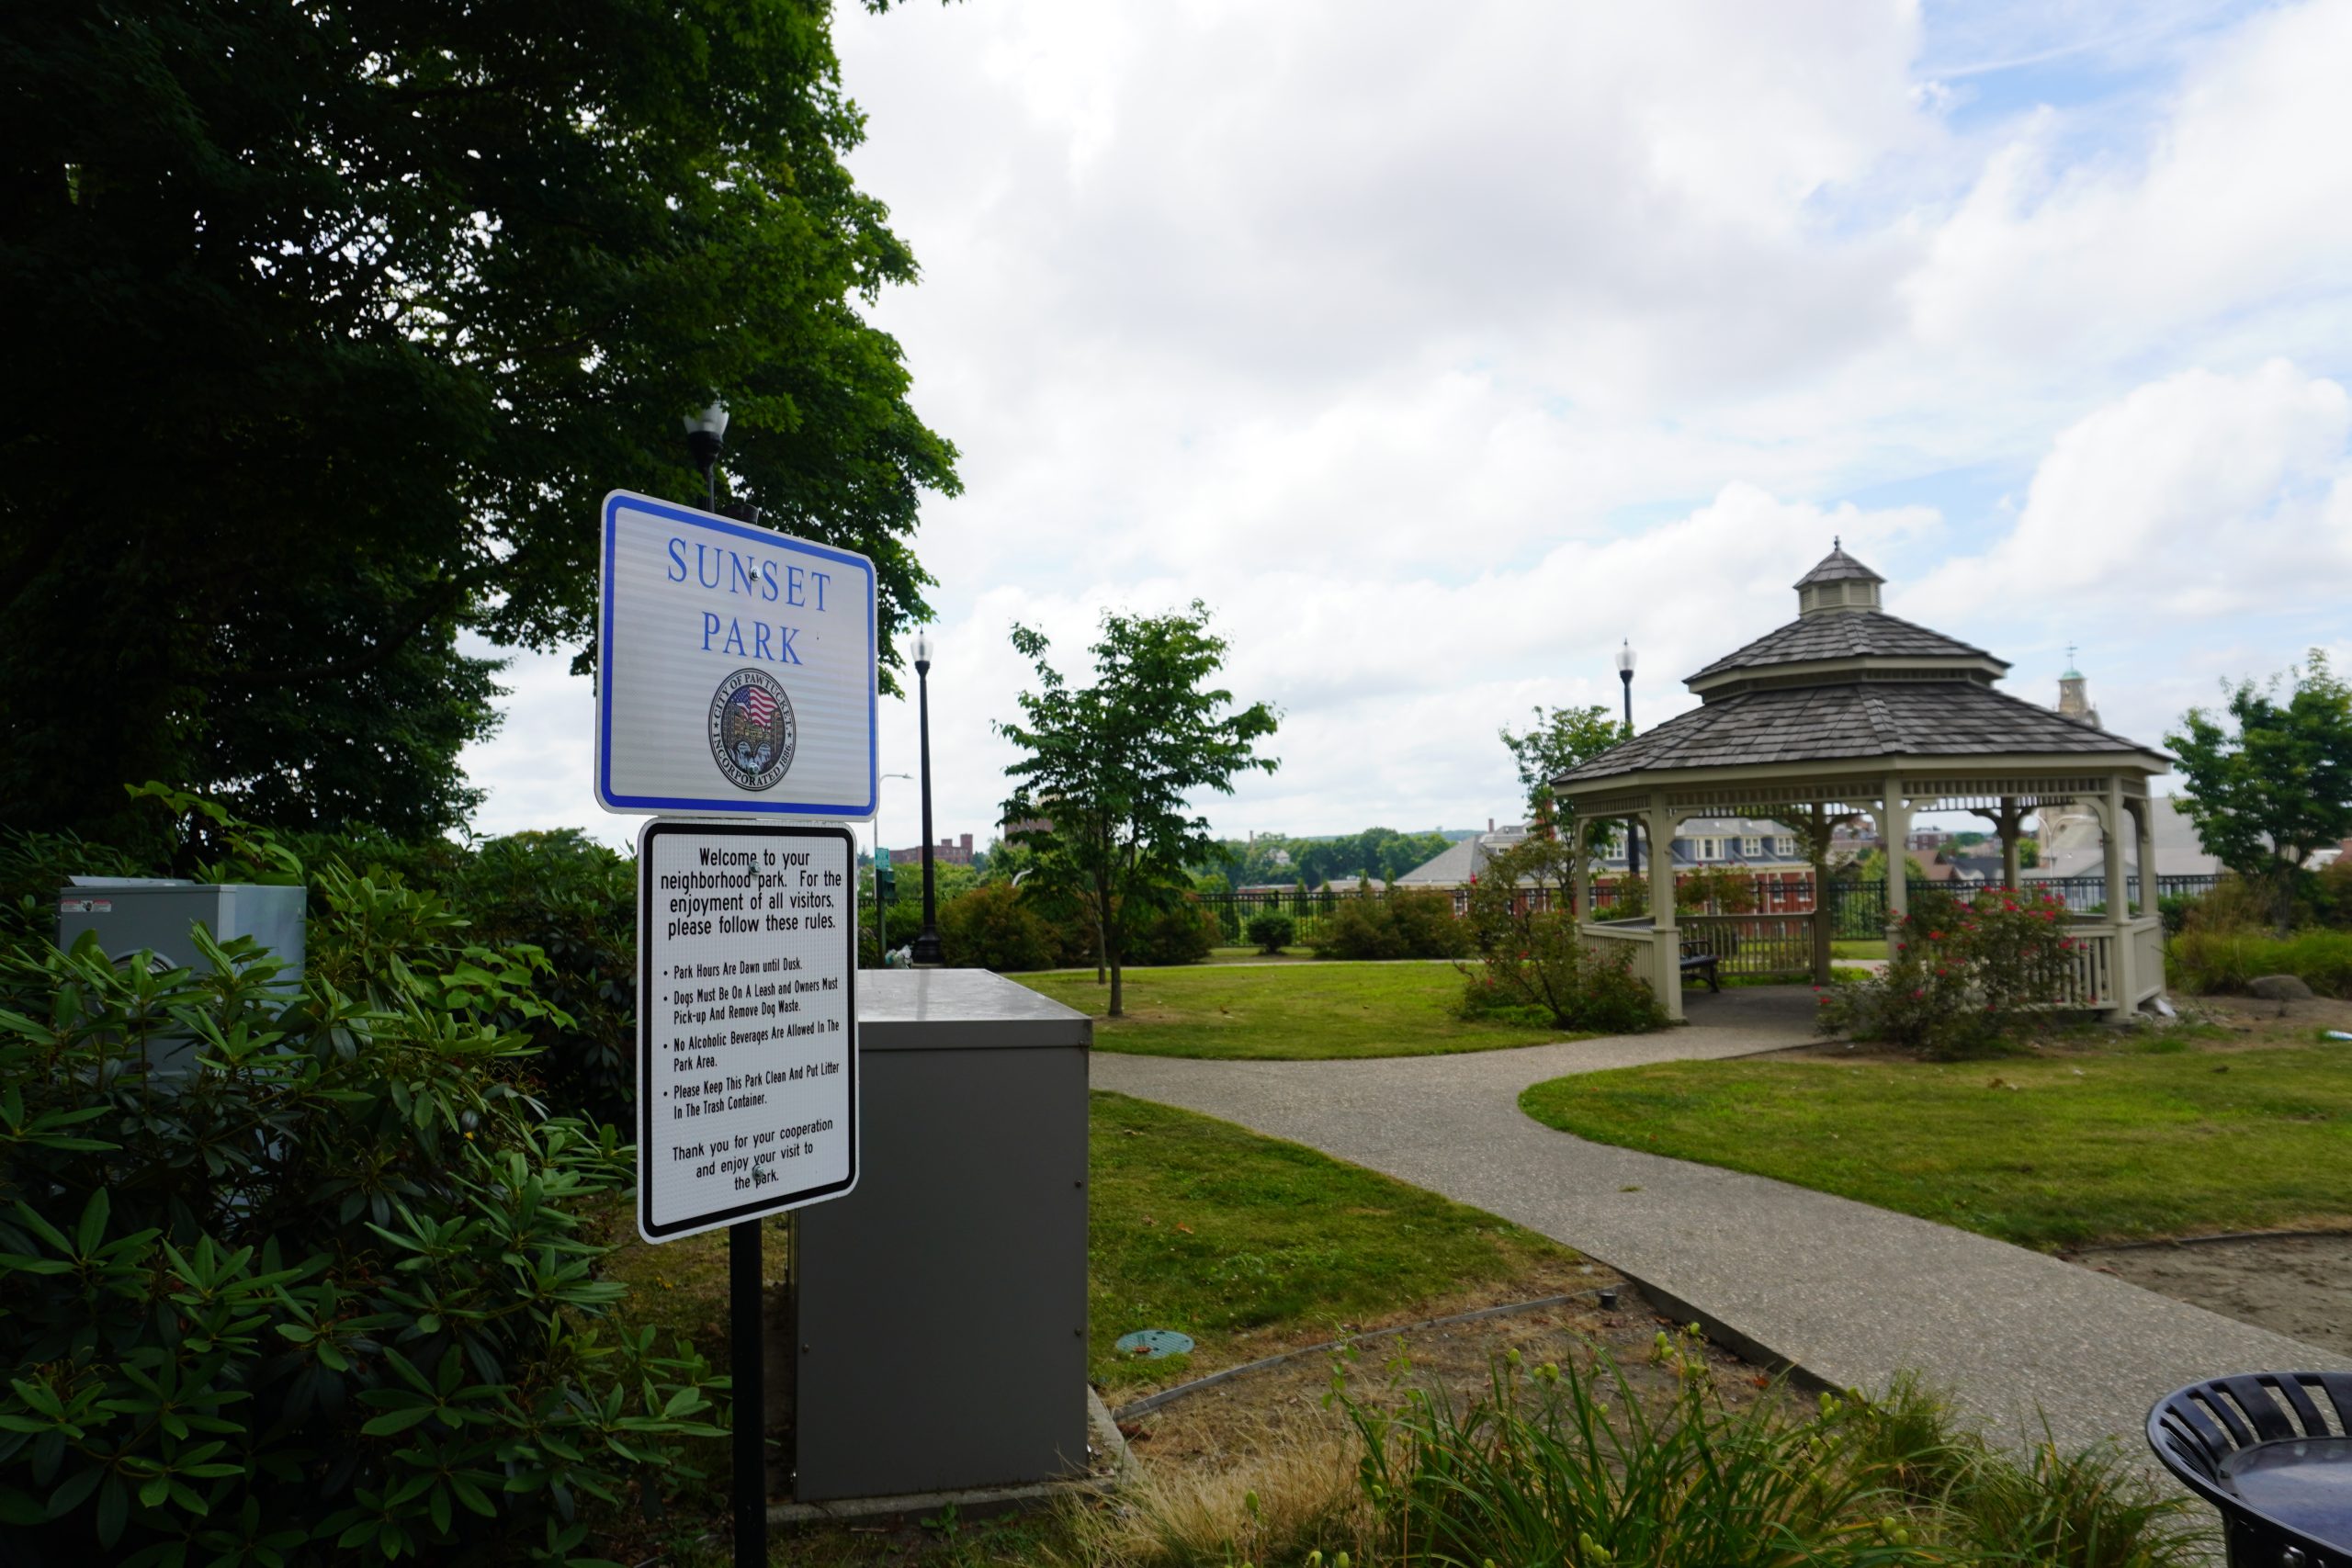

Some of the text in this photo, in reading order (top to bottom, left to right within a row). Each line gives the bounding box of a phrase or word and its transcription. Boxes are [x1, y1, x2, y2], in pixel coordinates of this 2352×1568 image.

[668, 537, 831, 611] SUNSET
[701, 611, 803, 665] PARK
[714, 688, 730, 718] CITY
[730, 675, 743, 689] OF
[714, 733, 780, 785] INCORPORATED
[700, 848, 809, 869] Welcome to your
[662, 871, 841, 895] neighborhood park. For the
[671, 892, 834, 918] enjoyment of all visitors,
[669, 913, 835, 941] please follow these rules.
[674, 957, 802, 979] Park Hours Are Dawn until Dusk.
[674, 977, 838, 1008] Dogs Must Be On A Leash and Owners Must
[674, 998, 800, 1025] Pick-up And Remove Dog Waste.
[674, 1019, 839, 1052] No Alcoholic Beverages Are Allowed In The
[674, 1055, 718, 1072] Park Area.
[674, 1062, 839, 1099] Please Keep This Park Clean And Put Litter
[674, 1093, 767, 1120] In The Trash Container.
[673, 1120, 832, 1161] Thank you for your cooperation
[696, 1143, 813, 1179] and enjoy your visit to
[735, 1176, 751, 1190] the
